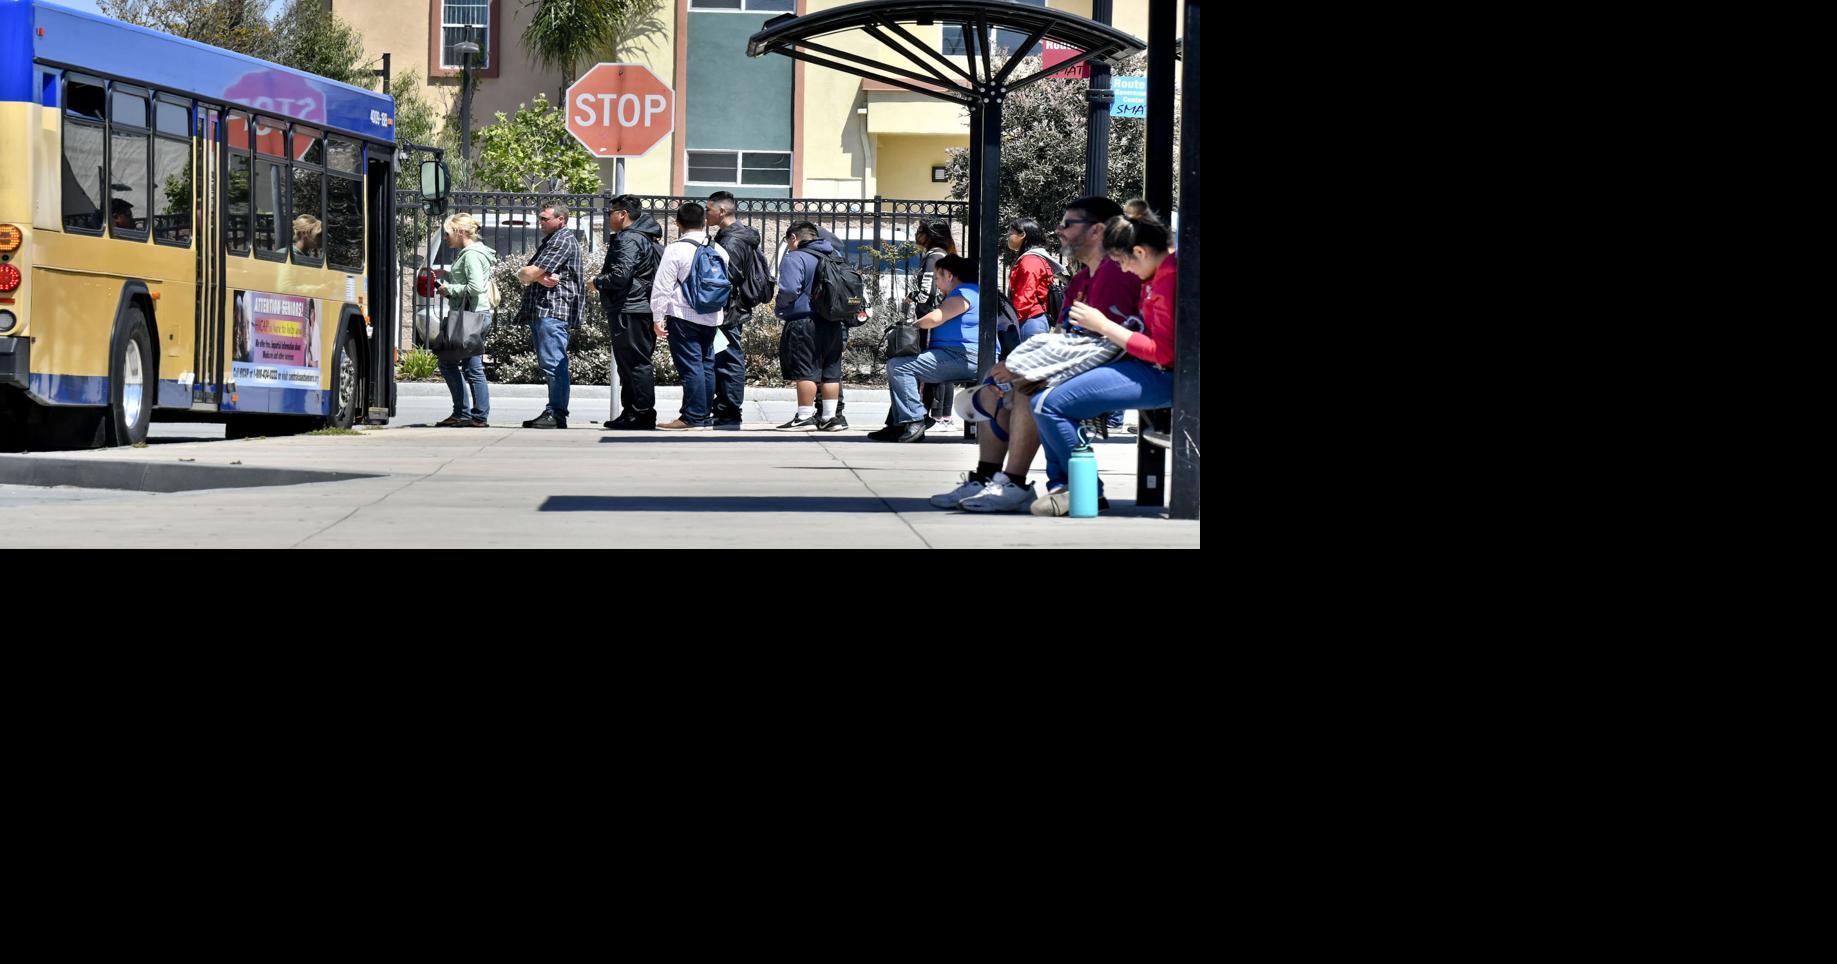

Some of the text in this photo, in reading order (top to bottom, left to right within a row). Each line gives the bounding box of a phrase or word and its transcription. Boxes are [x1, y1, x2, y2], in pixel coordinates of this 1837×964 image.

[1113, 79, 1145, 90] Route
[574, 93, 667, 127] STOP
[1116, 104, 1146, 115] SMA
[254, 297, 304, 317] ATTENTION SENIORS!
